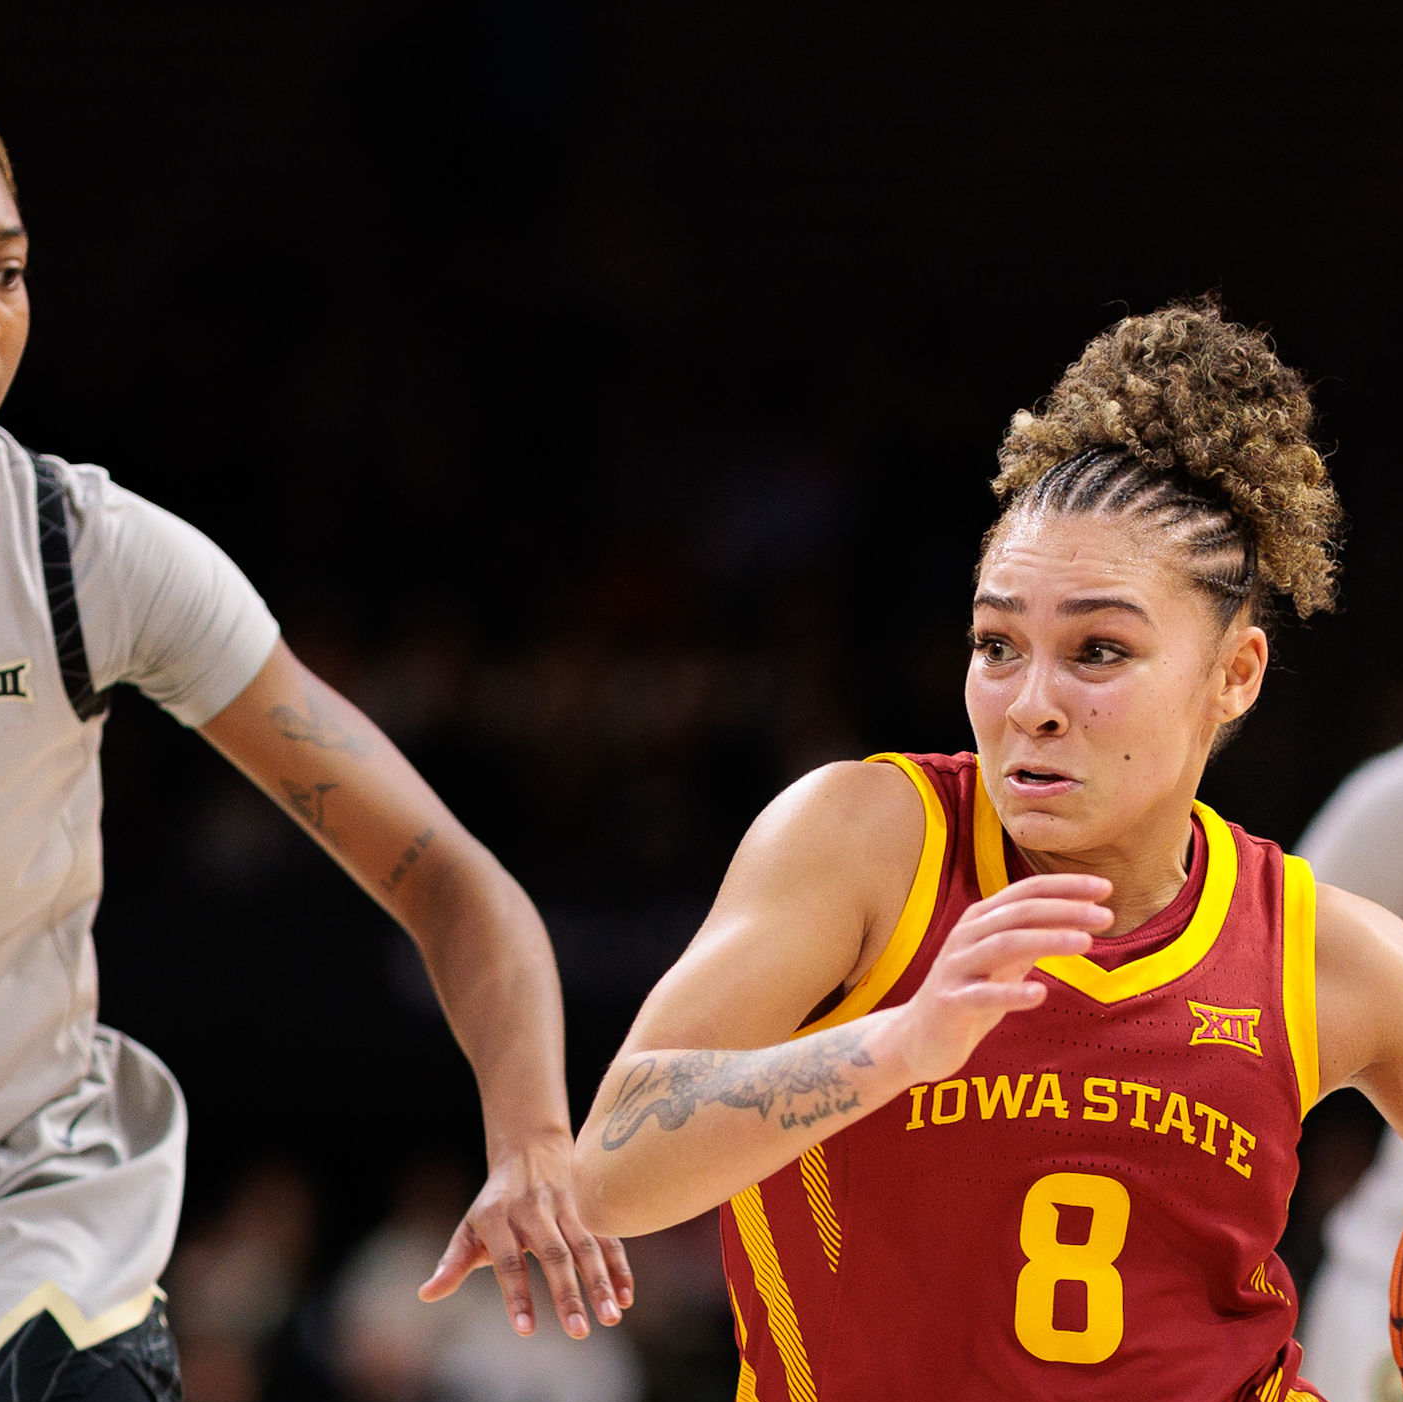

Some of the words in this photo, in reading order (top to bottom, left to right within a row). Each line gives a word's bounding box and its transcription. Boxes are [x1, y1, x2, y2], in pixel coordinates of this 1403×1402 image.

[1195, 1004, 1256, 1045] XII
[905, 1072, 1069, 1131] IOWA
[1082, 1076, 1257, 1179] STATE
[1014, 1172, 1131, 1364] 8
